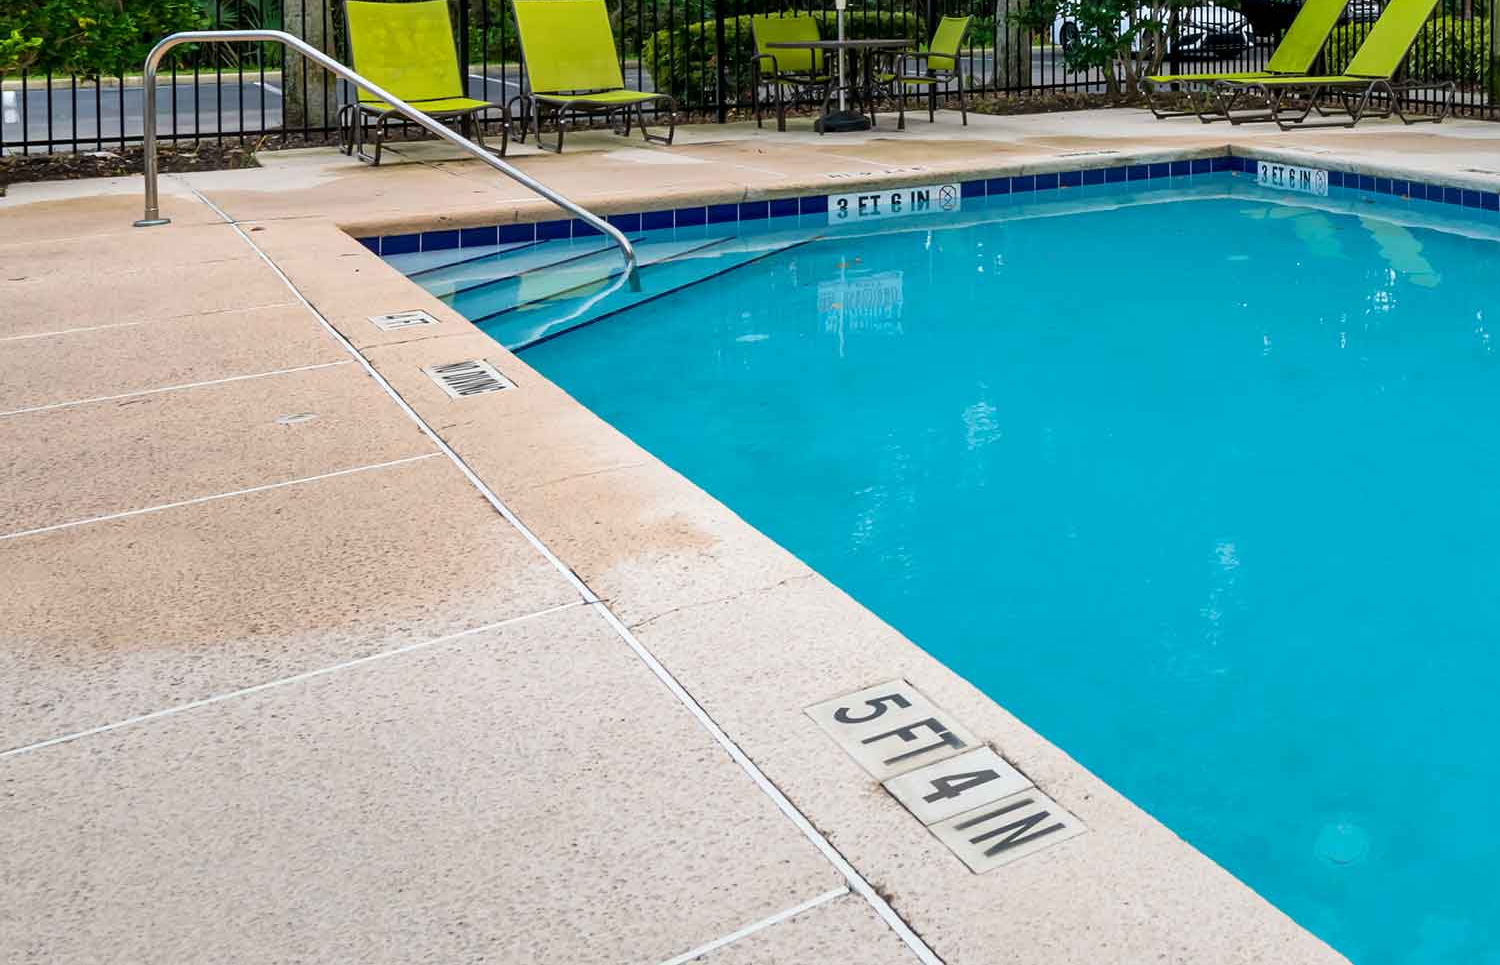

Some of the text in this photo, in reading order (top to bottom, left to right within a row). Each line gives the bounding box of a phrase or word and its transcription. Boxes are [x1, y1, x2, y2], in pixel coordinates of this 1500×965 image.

[1300, 170, 1311, 182] IN
[837, 198, 848, 211] 3
[858, 195, 881, 208] FT
[911, 189, 930, 203] IN
[833, 693, 968, 766] 5 FT
[922, 768, 1066, 857] 4 IN
